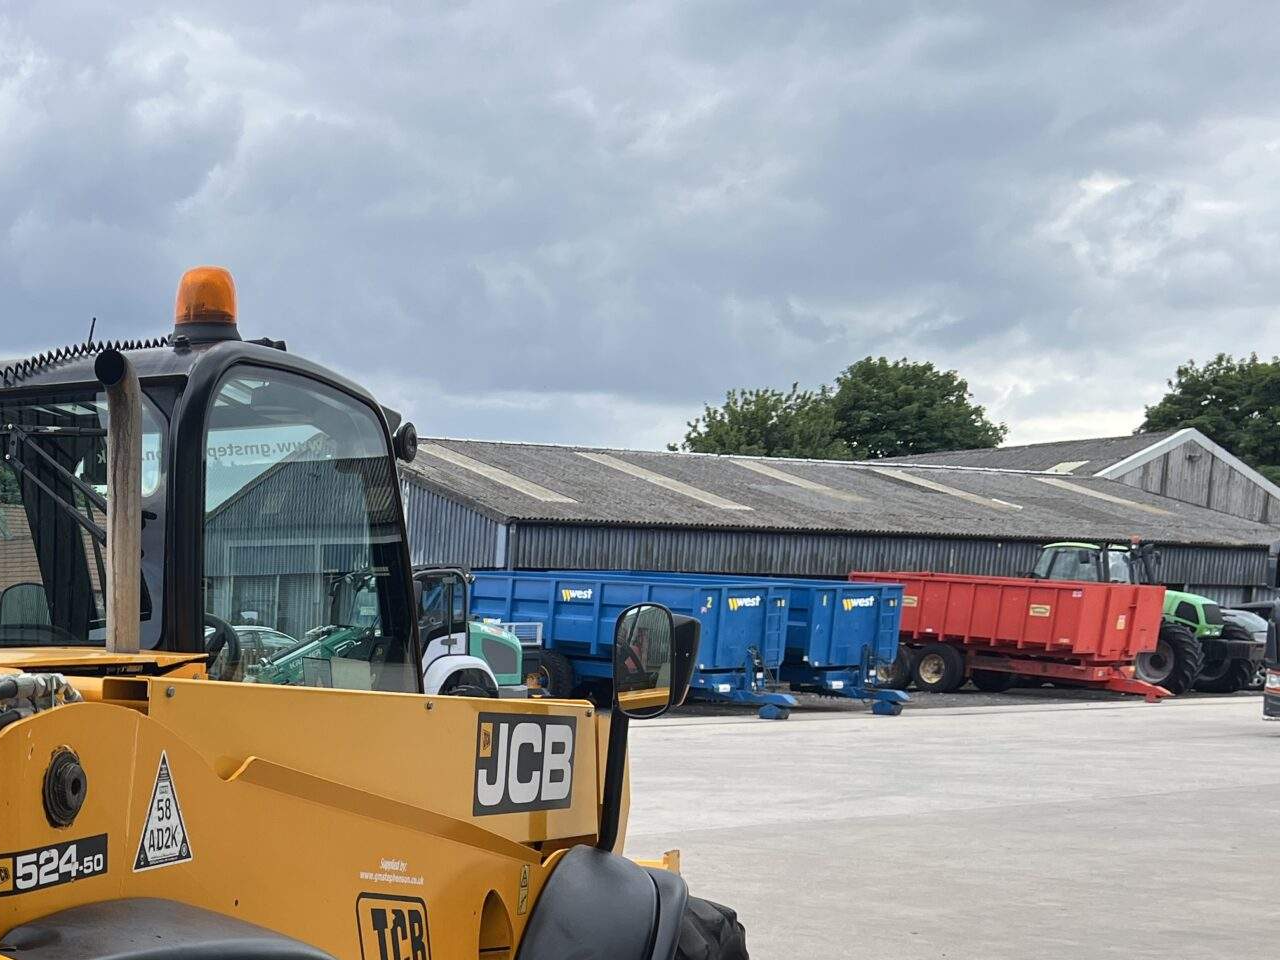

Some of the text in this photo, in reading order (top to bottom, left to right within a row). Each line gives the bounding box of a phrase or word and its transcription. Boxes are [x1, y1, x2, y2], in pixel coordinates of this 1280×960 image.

[566, 588, 593, 600] west
[733, 596, 761, 608] west
[847, 595, 875, 607] west
[477, 722, 573, 806] JCB
[157, 797, 172, 823] 58
[148, 824, 179, 853] AD2K
